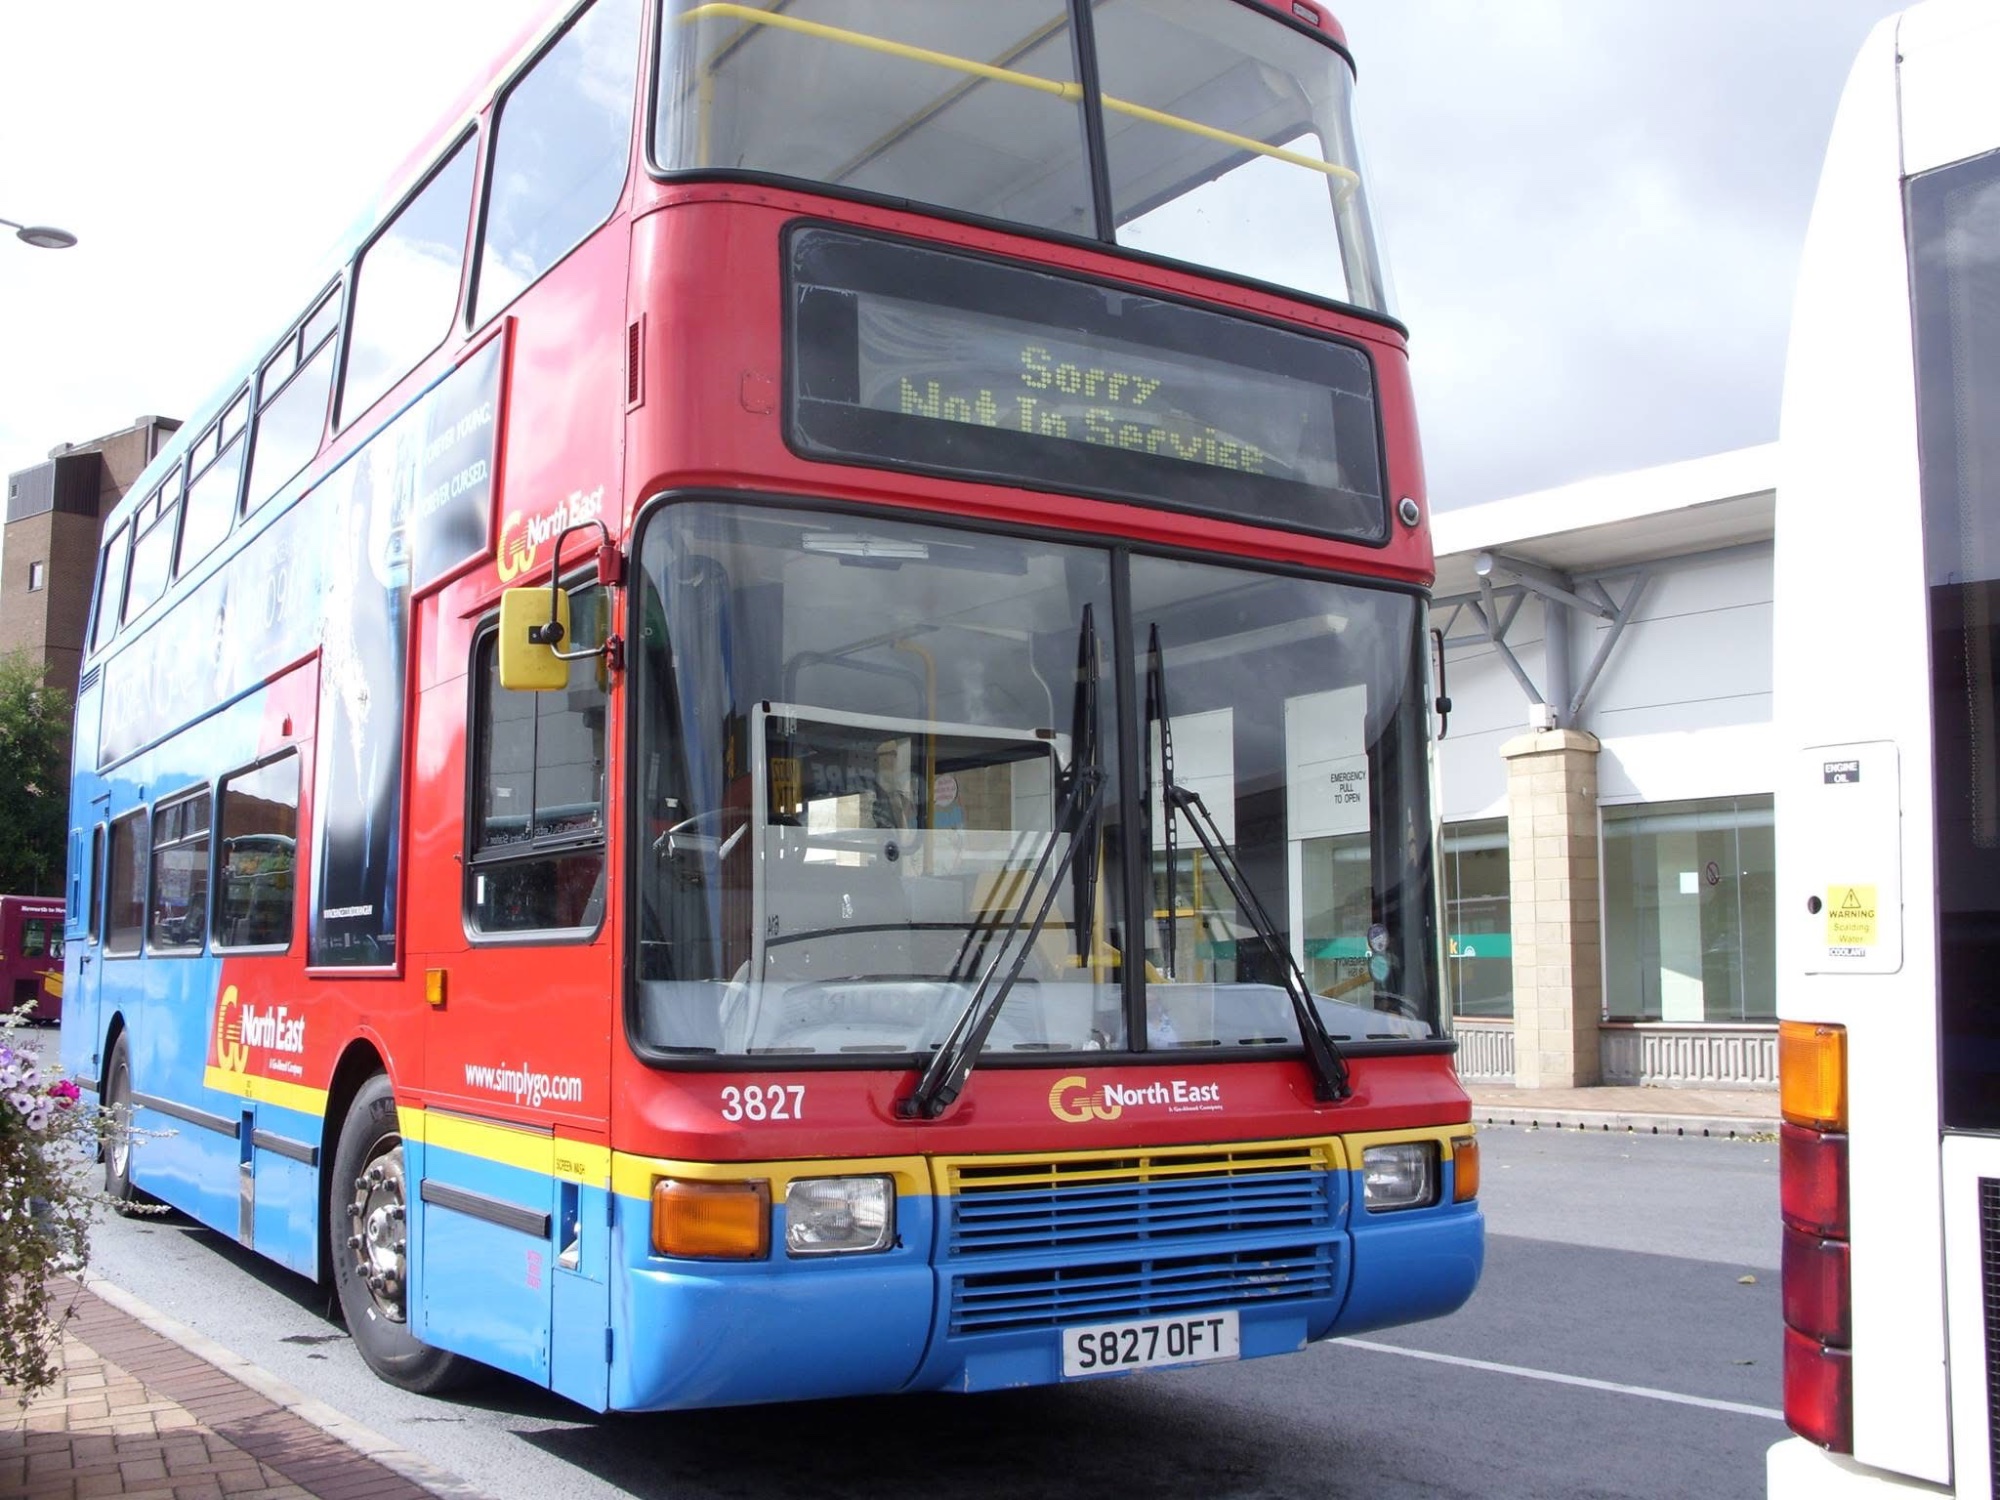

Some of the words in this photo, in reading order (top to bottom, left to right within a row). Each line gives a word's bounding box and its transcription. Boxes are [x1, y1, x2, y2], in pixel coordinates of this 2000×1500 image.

[1021, 346, 1161, 405] Sorry
[900, 376, 997, 427] Not
[1016, 396, 1067, 439] In
[1084, 407, 1265, 475] Service
[526, 500, 569, 551] North
[568, 484, 604, 527] East
[1331, 771, 1366, 783] EMERGENCY
[1825, 762, 1858, 773] ENGINE
[1834, 774, 1850, 783] OIL
[1334, 795, 1342, 804] TO
[1345, 793, 1360, 803] OPEN
[1340, 784, 1353, 792] PULL
[1829, 910, 1875, 918] WARNING
[240, 1003, 276, 1049] North
[275, 1005, 306, 1054] East
[464, 1061, 582, 1107] www.simplygo.com
[1102, 1082, 1170, 1107] North
[1171, 1080, 1220, 1103] East
[721, 1085, 805, 1121] 3827
[1077, 1326, 1159, 1369] S827
[1167, 1318, 1224, 1357] OFT
